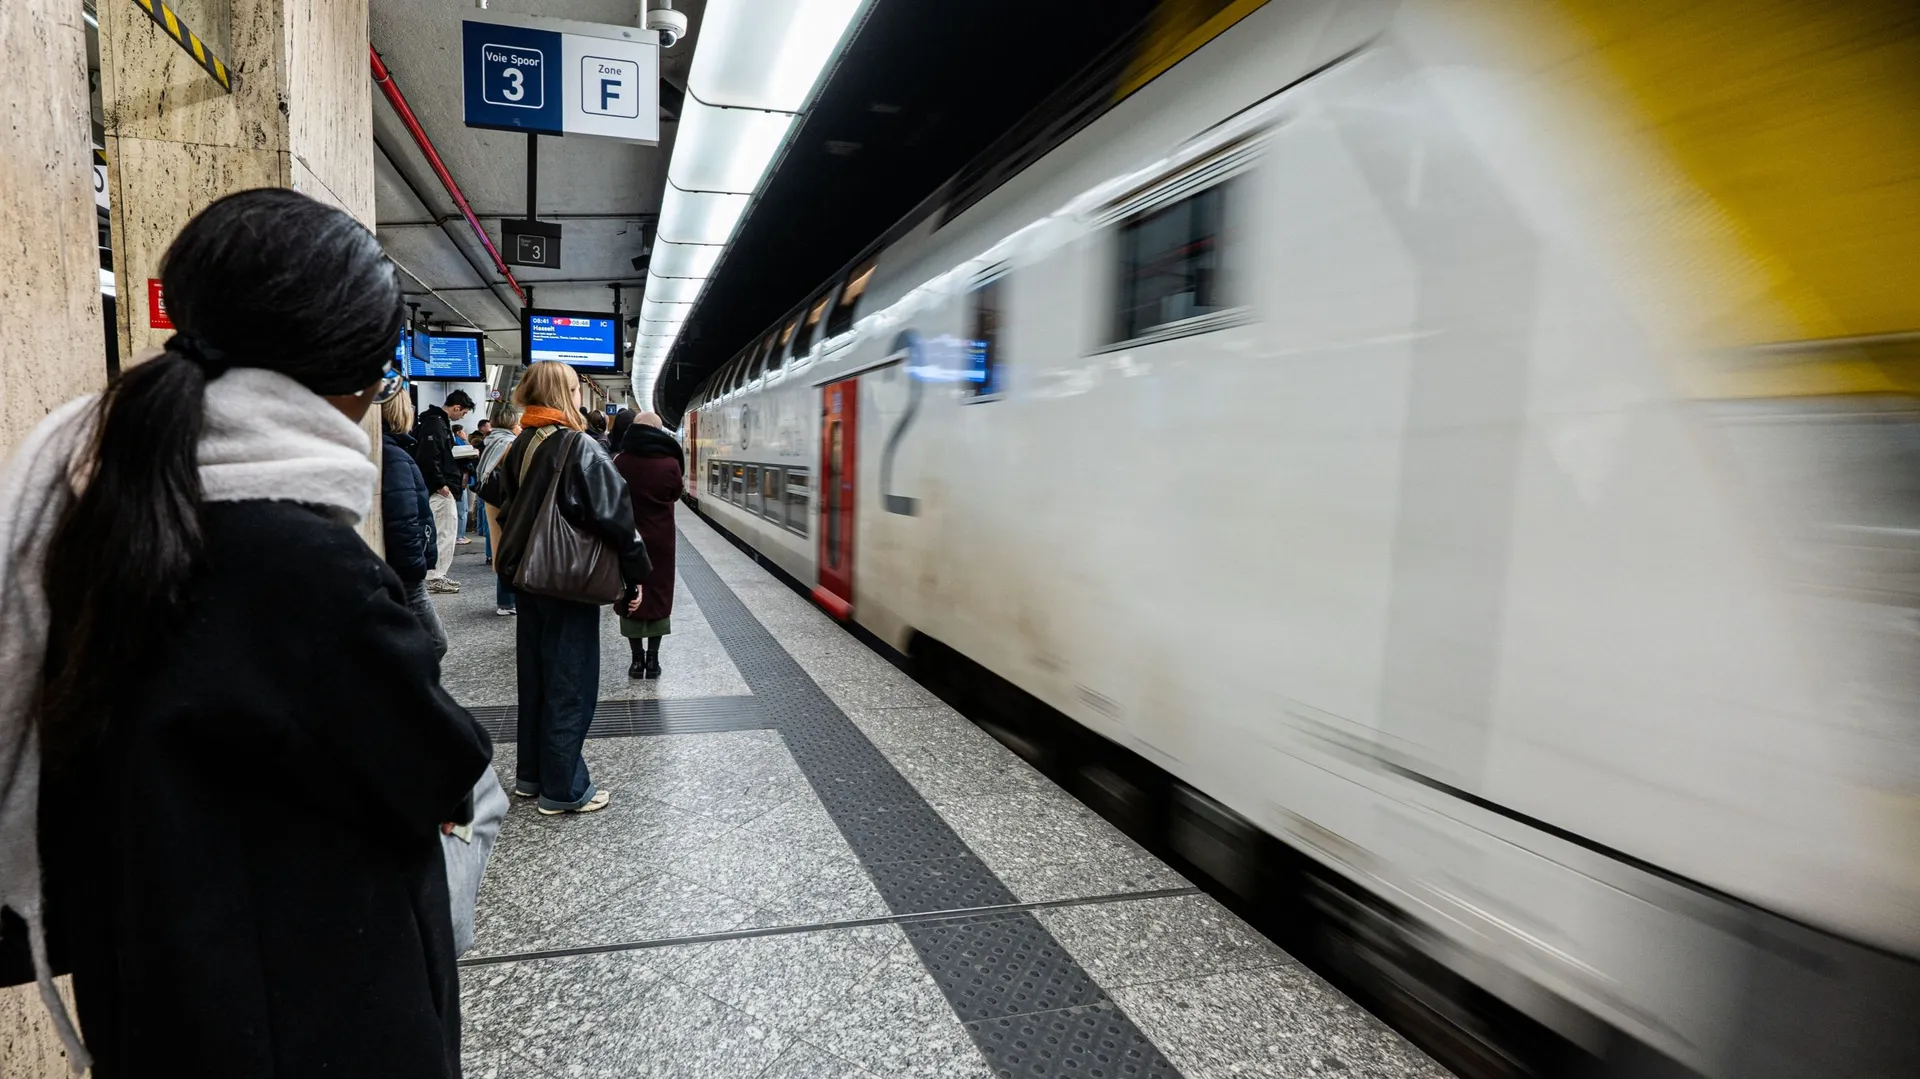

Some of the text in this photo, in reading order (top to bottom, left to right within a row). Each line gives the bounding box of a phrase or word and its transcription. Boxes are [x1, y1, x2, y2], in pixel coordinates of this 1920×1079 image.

[485, 51, 540, 67] Voie Spoor
[598, 64, 622, 76] Zone
[502, 67, 525, 101] 3
[600, 78, 622, 110] F
[532, 245, 541, 259] 3
